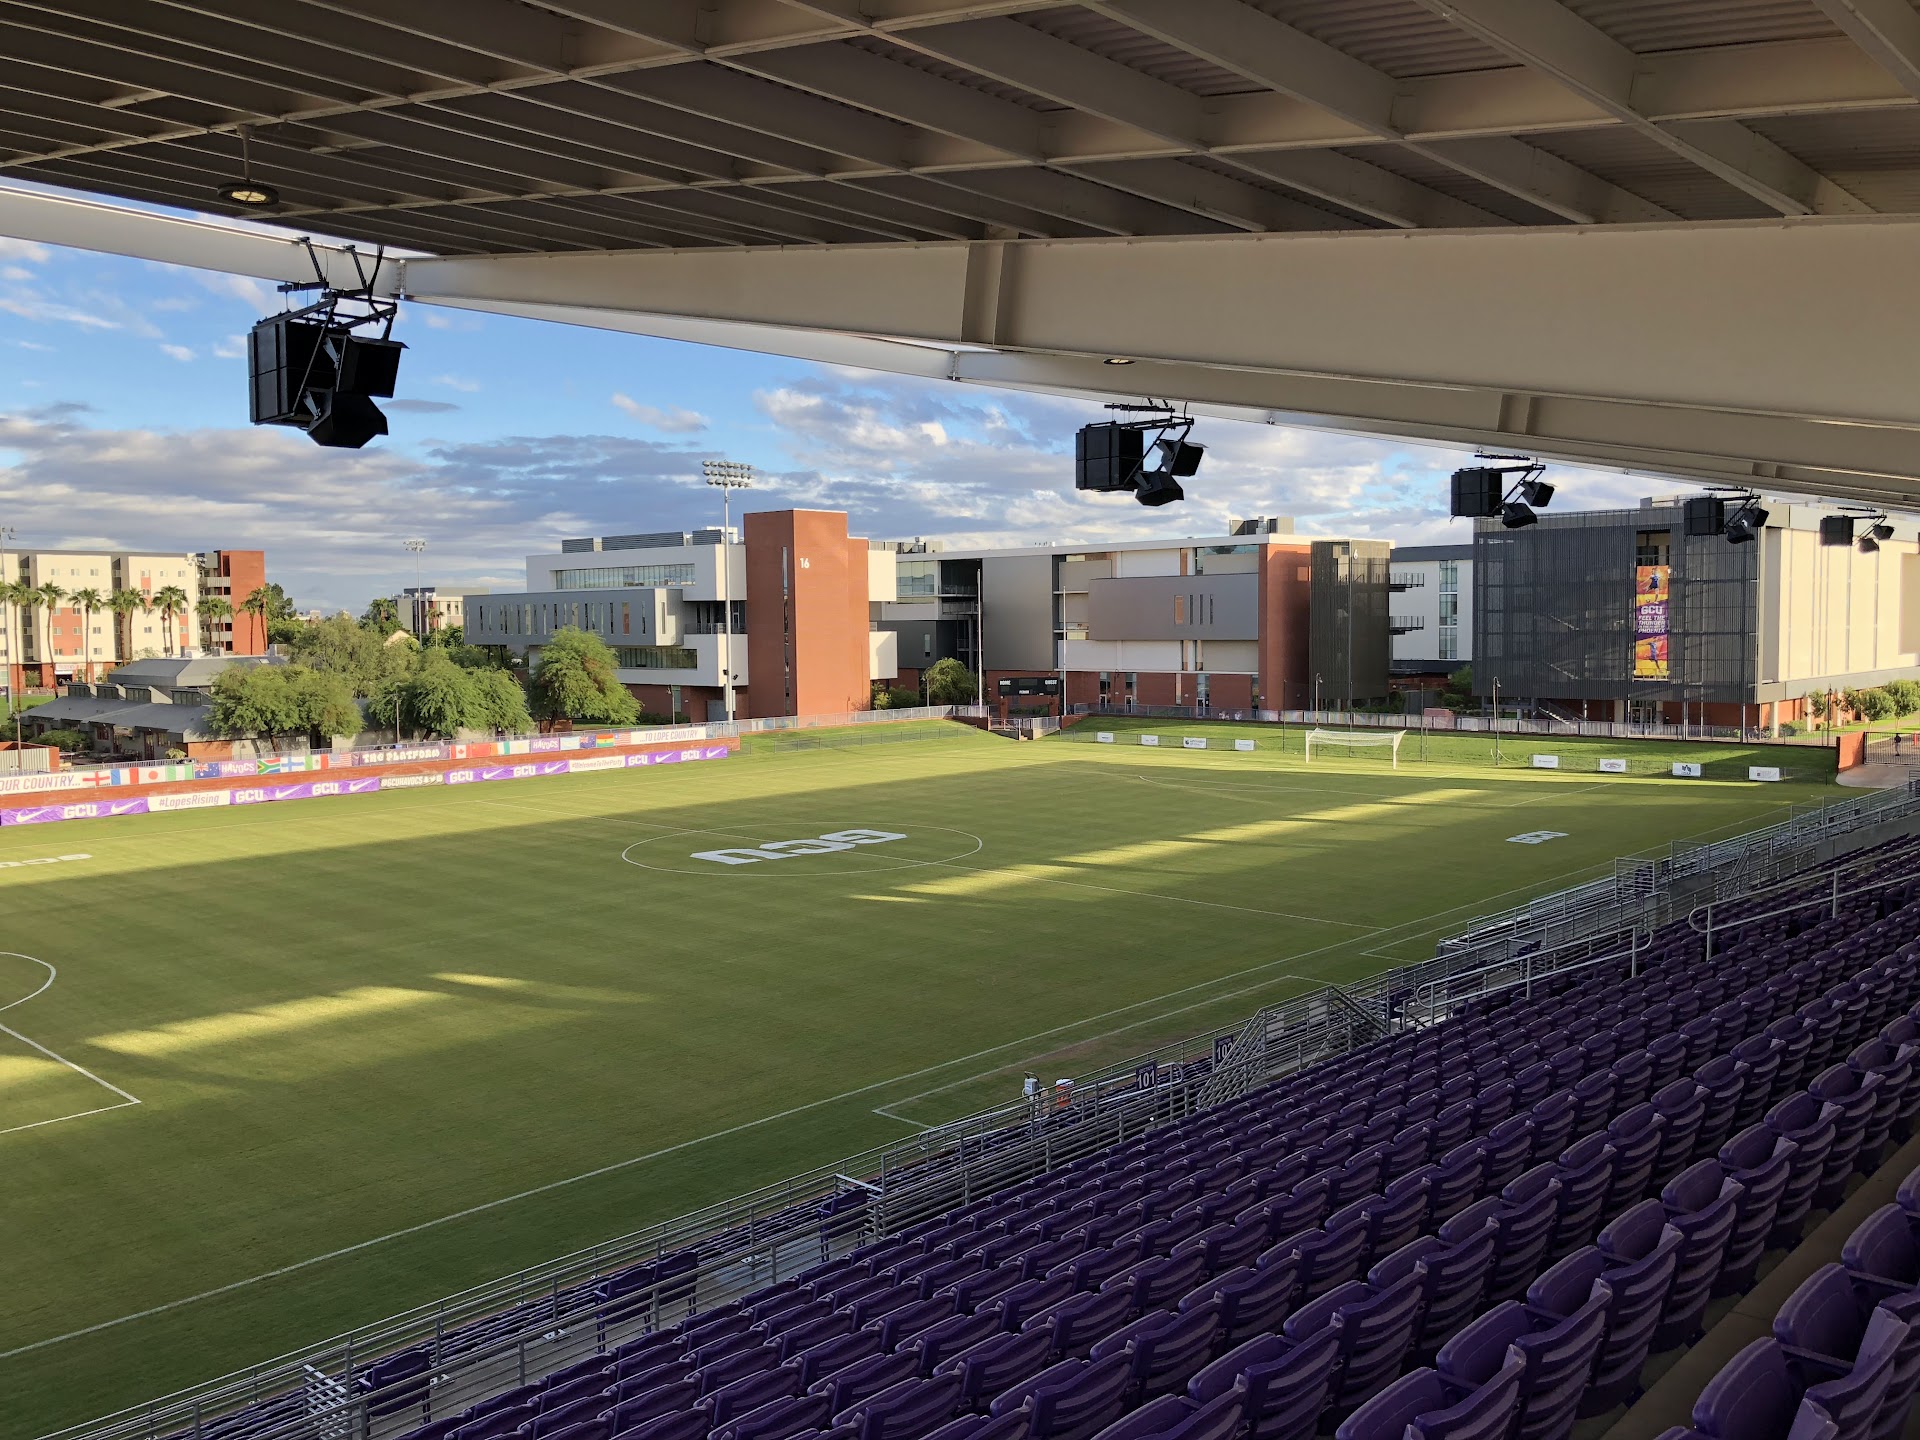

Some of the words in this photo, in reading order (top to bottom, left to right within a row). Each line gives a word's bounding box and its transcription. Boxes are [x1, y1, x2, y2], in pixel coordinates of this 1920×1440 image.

[799, 557, 810, 569] 16
[1641, 606, 1662, 614] GCU
[653, 731, 670, 742] LOPE
[670, 729, 699, 740] COUNTRY
[533, 739, 559, 750] HAVOCS
[386, 748, 441, 761] PLATFORM
[628, 754, 649, 766] GCU
[681, 749, 701, 760] GCU
[221, 761, 255, 774] HAVOCS
[513, 765, 537, 778] GCU
[380, 776, 424, 788] @GCUHAVOCS
[449, 770, 474, 783] GCU
[311, 782, 340, 797] GCU
[158, 793, 220, 808] #LopesRising
[235, 789, 265, 804] GCU
[63, 804, 98, 819] GCU
[690, 829, 908, 865] GCU
[1136, 1070, 1154, 1090] 101
